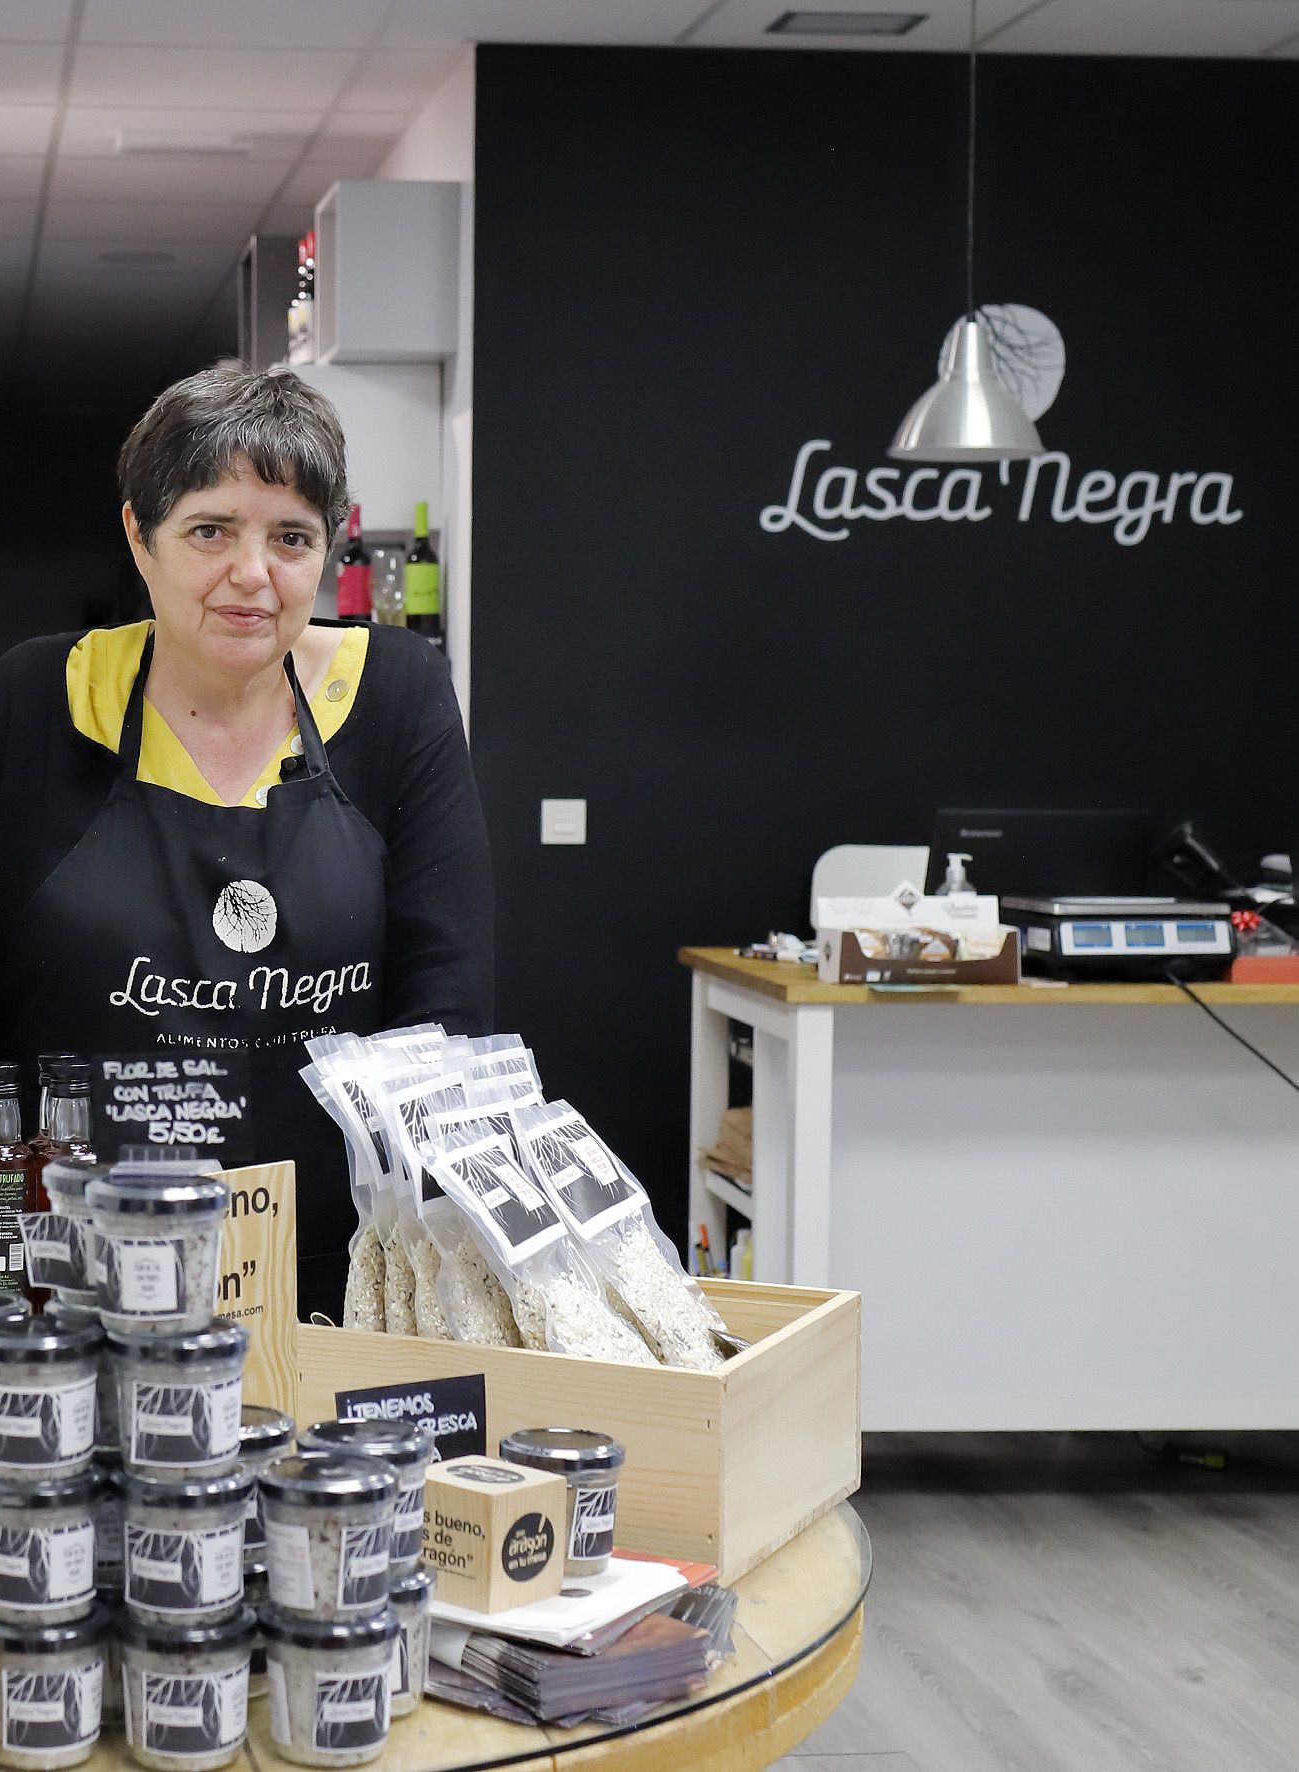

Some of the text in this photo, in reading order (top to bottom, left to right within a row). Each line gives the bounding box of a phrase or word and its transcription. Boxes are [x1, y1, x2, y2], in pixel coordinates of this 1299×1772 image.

[759, 439, 1244, 547] Lasca Negra
[109, 956, 373, 1017] Lasca Negra
[156, 1032, 249, 1050] ALIMENTOS
[103, 1059, 229, 1080] FLOR DE SAL
[113, 1082, 221, 1101] CON TRUFA
[0, 1172, 25, 1184] TRUFADO
[215, 1304, 264, 1321] mesa.com
[423, 1510, 486, 1541] s bueno,
[422, 1528, 452, 1546] s de
[423, 1545, 474, 1569] ragón”
